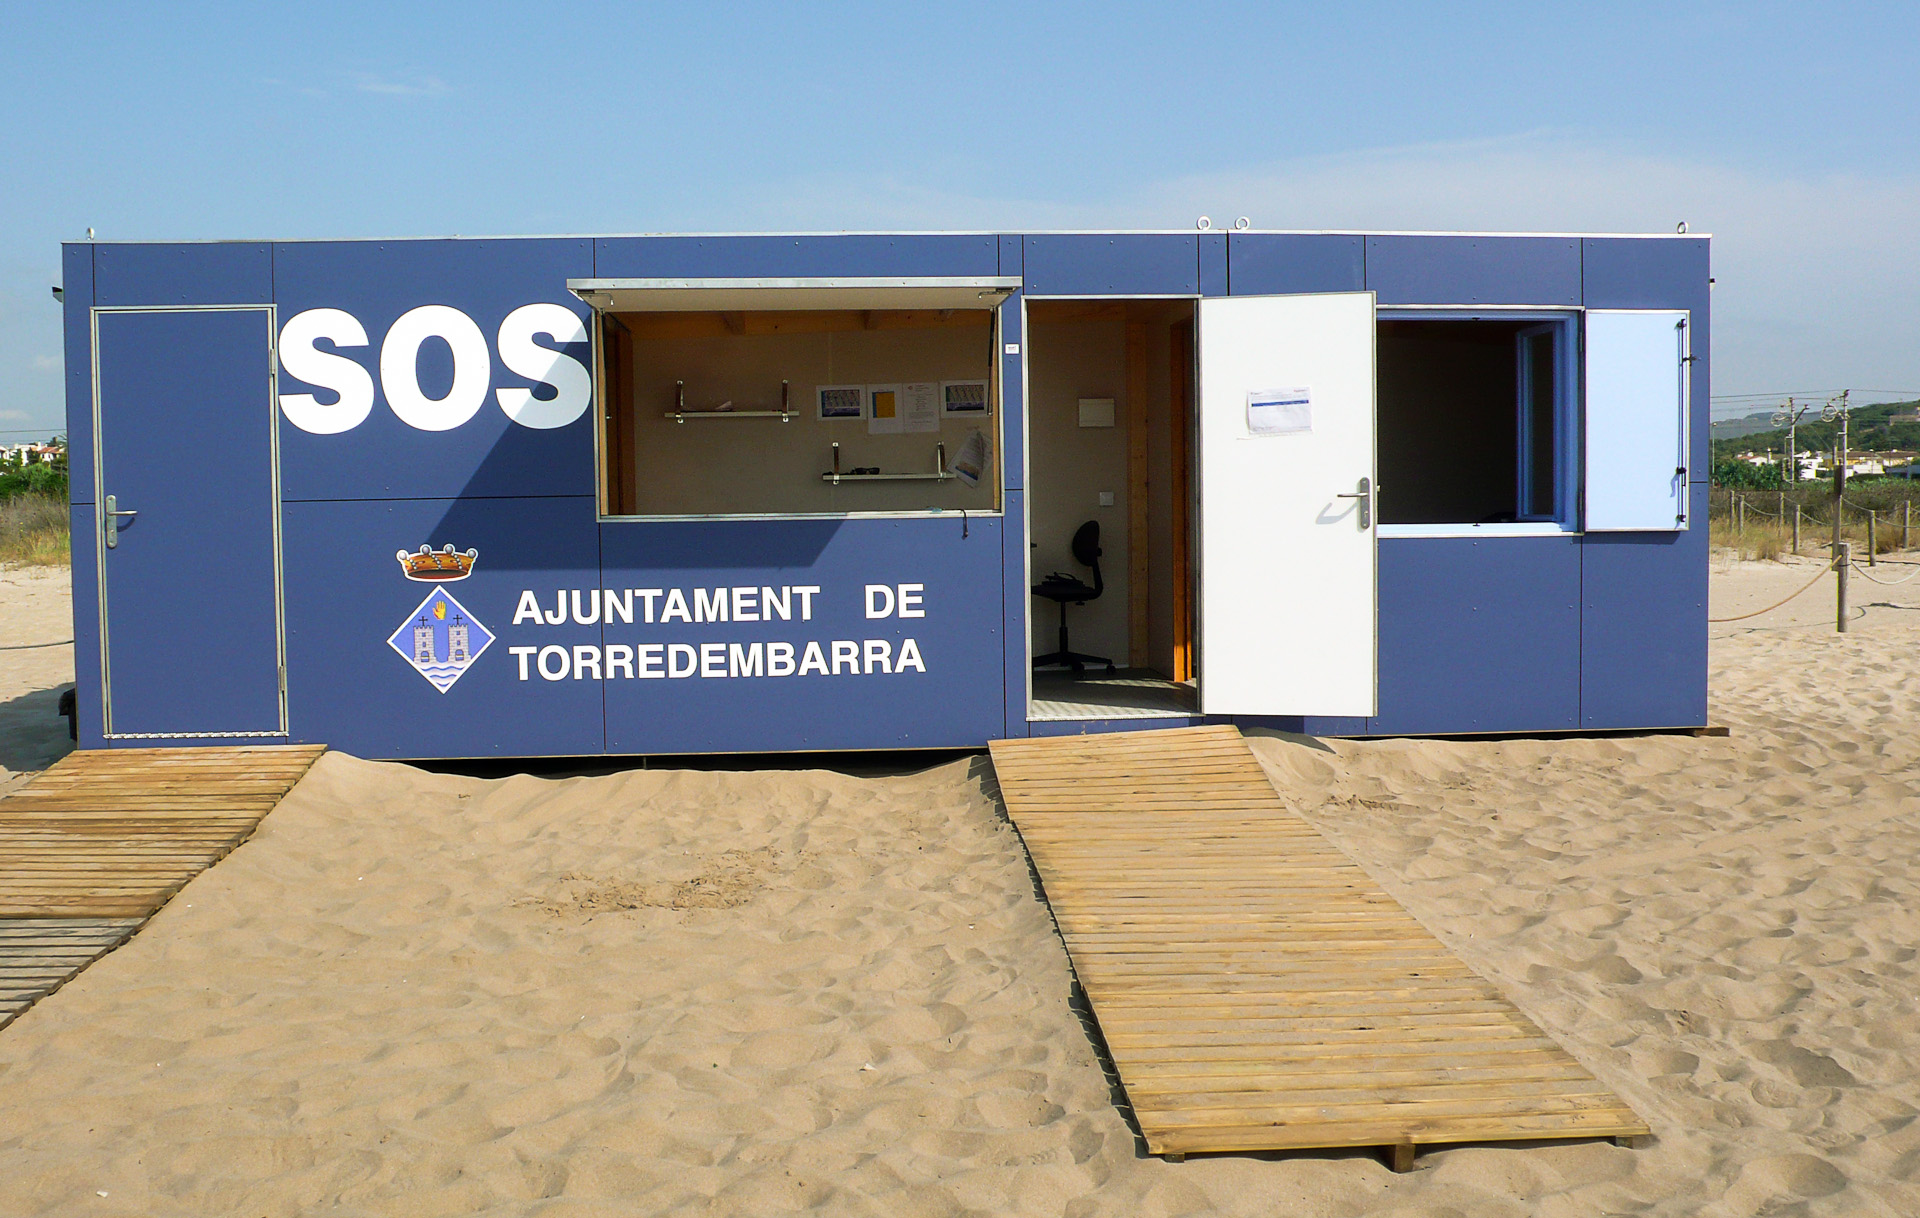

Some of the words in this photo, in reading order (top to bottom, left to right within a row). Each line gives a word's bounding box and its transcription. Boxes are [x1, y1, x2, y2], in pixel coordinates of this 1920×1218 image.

[278, 303, 592, 435] SOS
[512, 585, 821, 626] AJUNTAMENT
[864, 583, 926, 620] DE
[508, 638, 928, 682] TORREDEMBARRA
